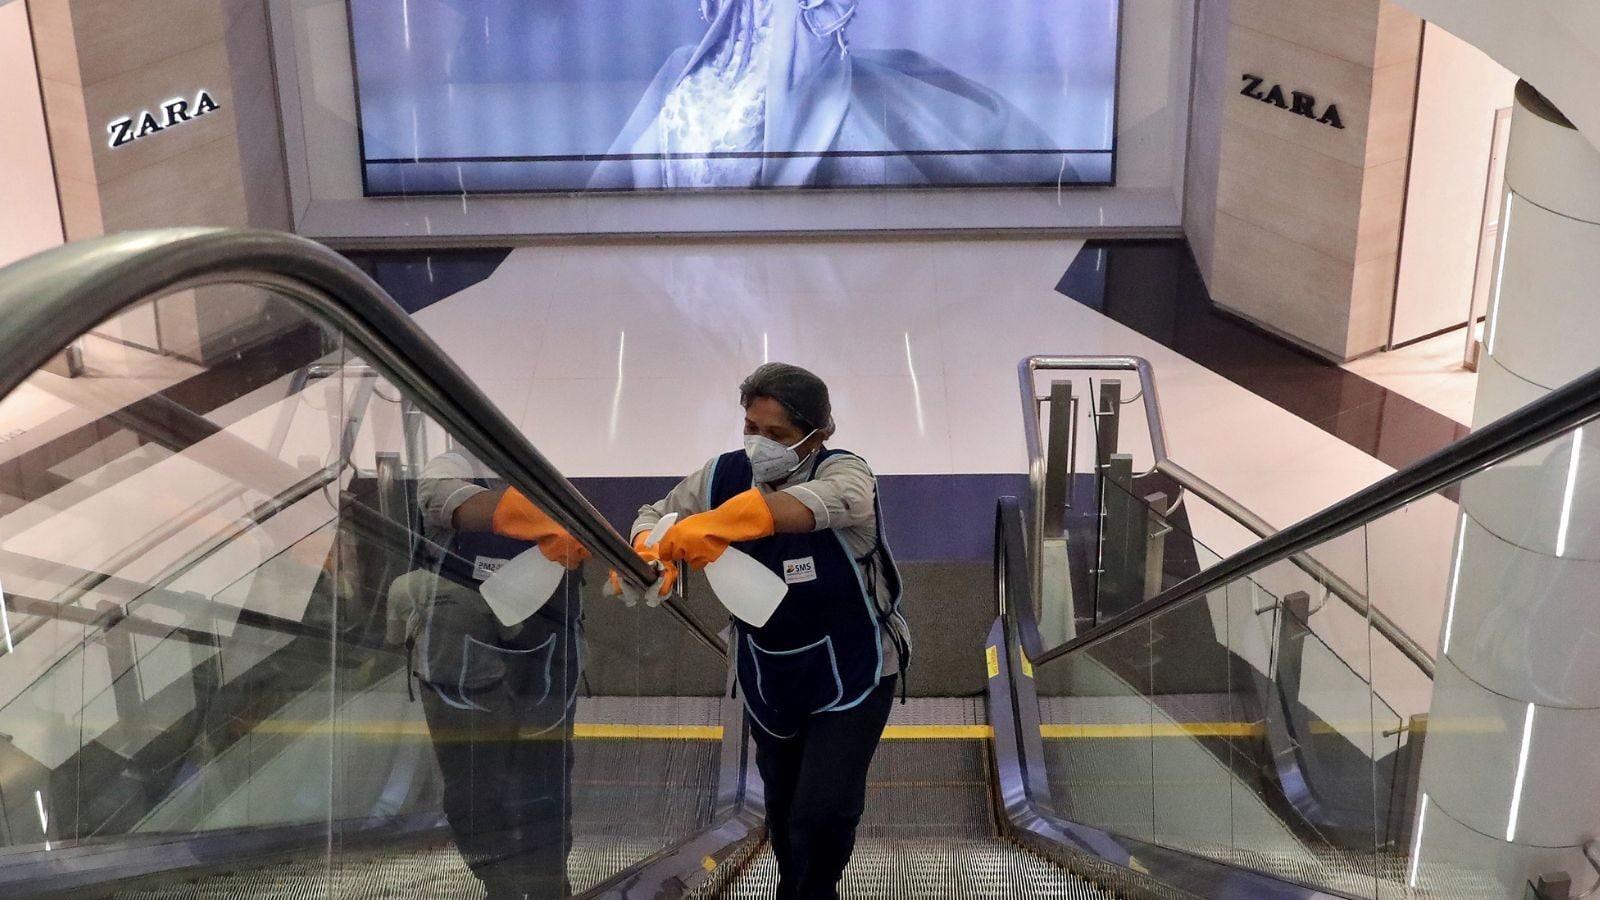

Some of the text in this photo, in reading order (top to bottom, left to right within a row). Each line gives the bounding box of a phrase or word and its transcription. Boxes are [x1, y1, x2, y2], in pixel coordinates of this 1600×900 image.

[109, 90, 221, 148] ZARA
[1240, 73, 1346, 130] ZARA
[794, 562, 812, 573] SMS
